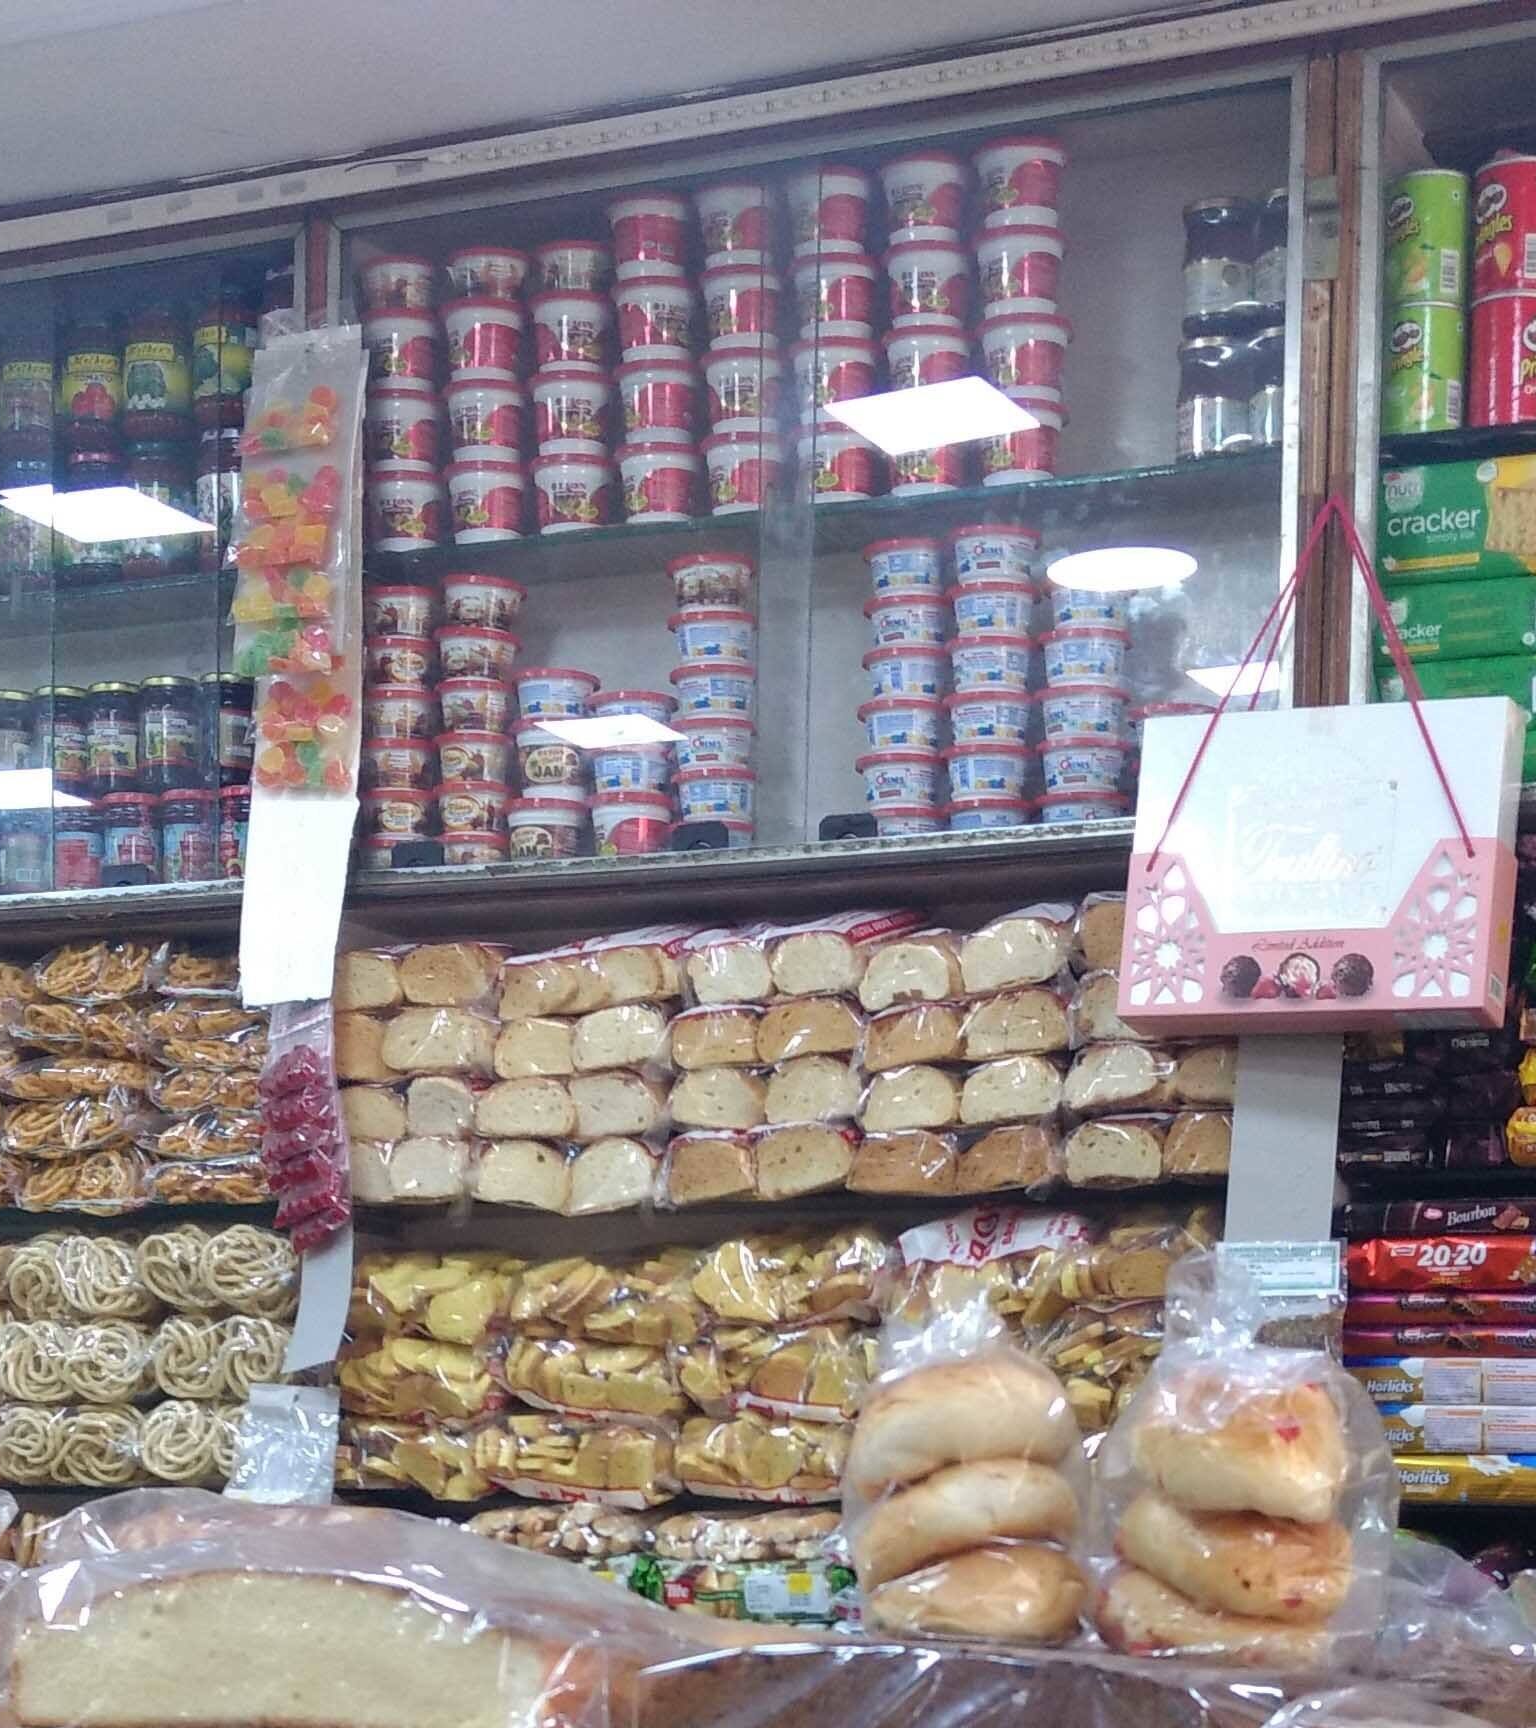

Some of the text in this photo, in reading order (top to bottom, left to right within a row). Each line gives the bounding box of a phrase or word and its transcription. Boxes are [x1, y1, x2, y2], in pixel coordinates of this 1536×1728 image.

[1387, 507, 1481, 537] cracker
[1446, 1203, 1497, 1228] Bourbon
[1366, 1379, 1415, 1395] Horlicks
